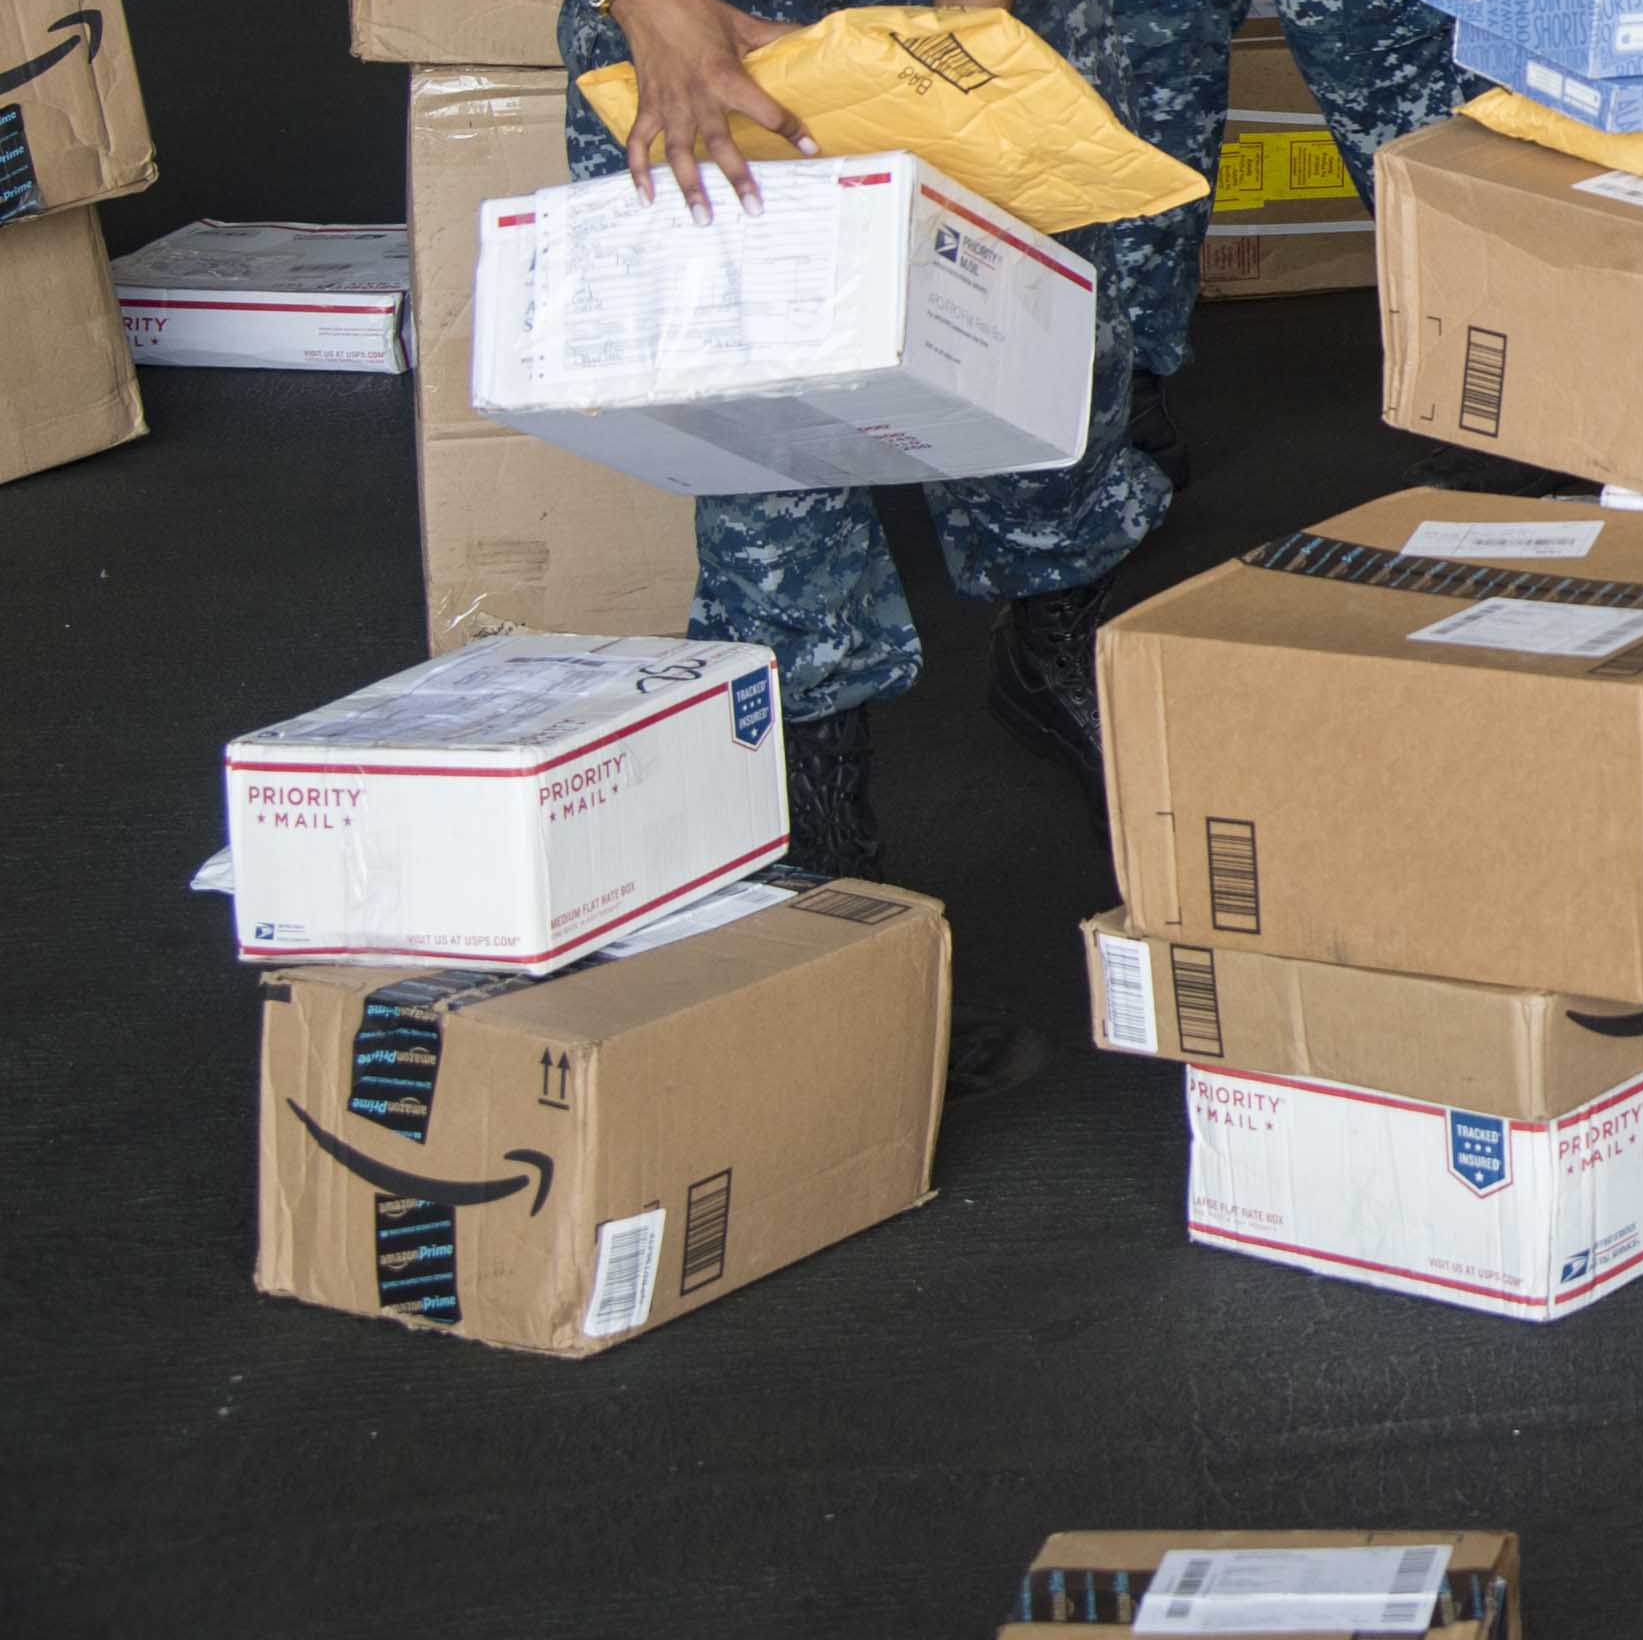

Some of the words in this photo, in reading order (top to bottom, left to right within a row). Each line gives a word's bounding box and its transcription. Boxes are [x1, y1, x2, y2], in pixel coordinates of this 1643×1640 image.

[736, 679, 769, 702] TRACKED
[739, 706, 769, 730] INSURED
[540, 754, 623, 806] PRIORITY
[248, 786, 361, 807] PRIORITY
[564, 787, 607, 820] MAIL
[274, 813, 334, 829] MAIL
[550, 907, 581, 931] MEDIUM
[1190, 1078, 1281, 1114] PRIORITY
[1206, 1105, 1258, 1131] MAIL
[1455, 1123, 1500, 1144] TRACKED
[1558, 1108, 1642, 1161] PRIORITY
[1458, 1151, 1500, 1171] INSURED
[1581, 1140, 1623, 1173] MAIL
